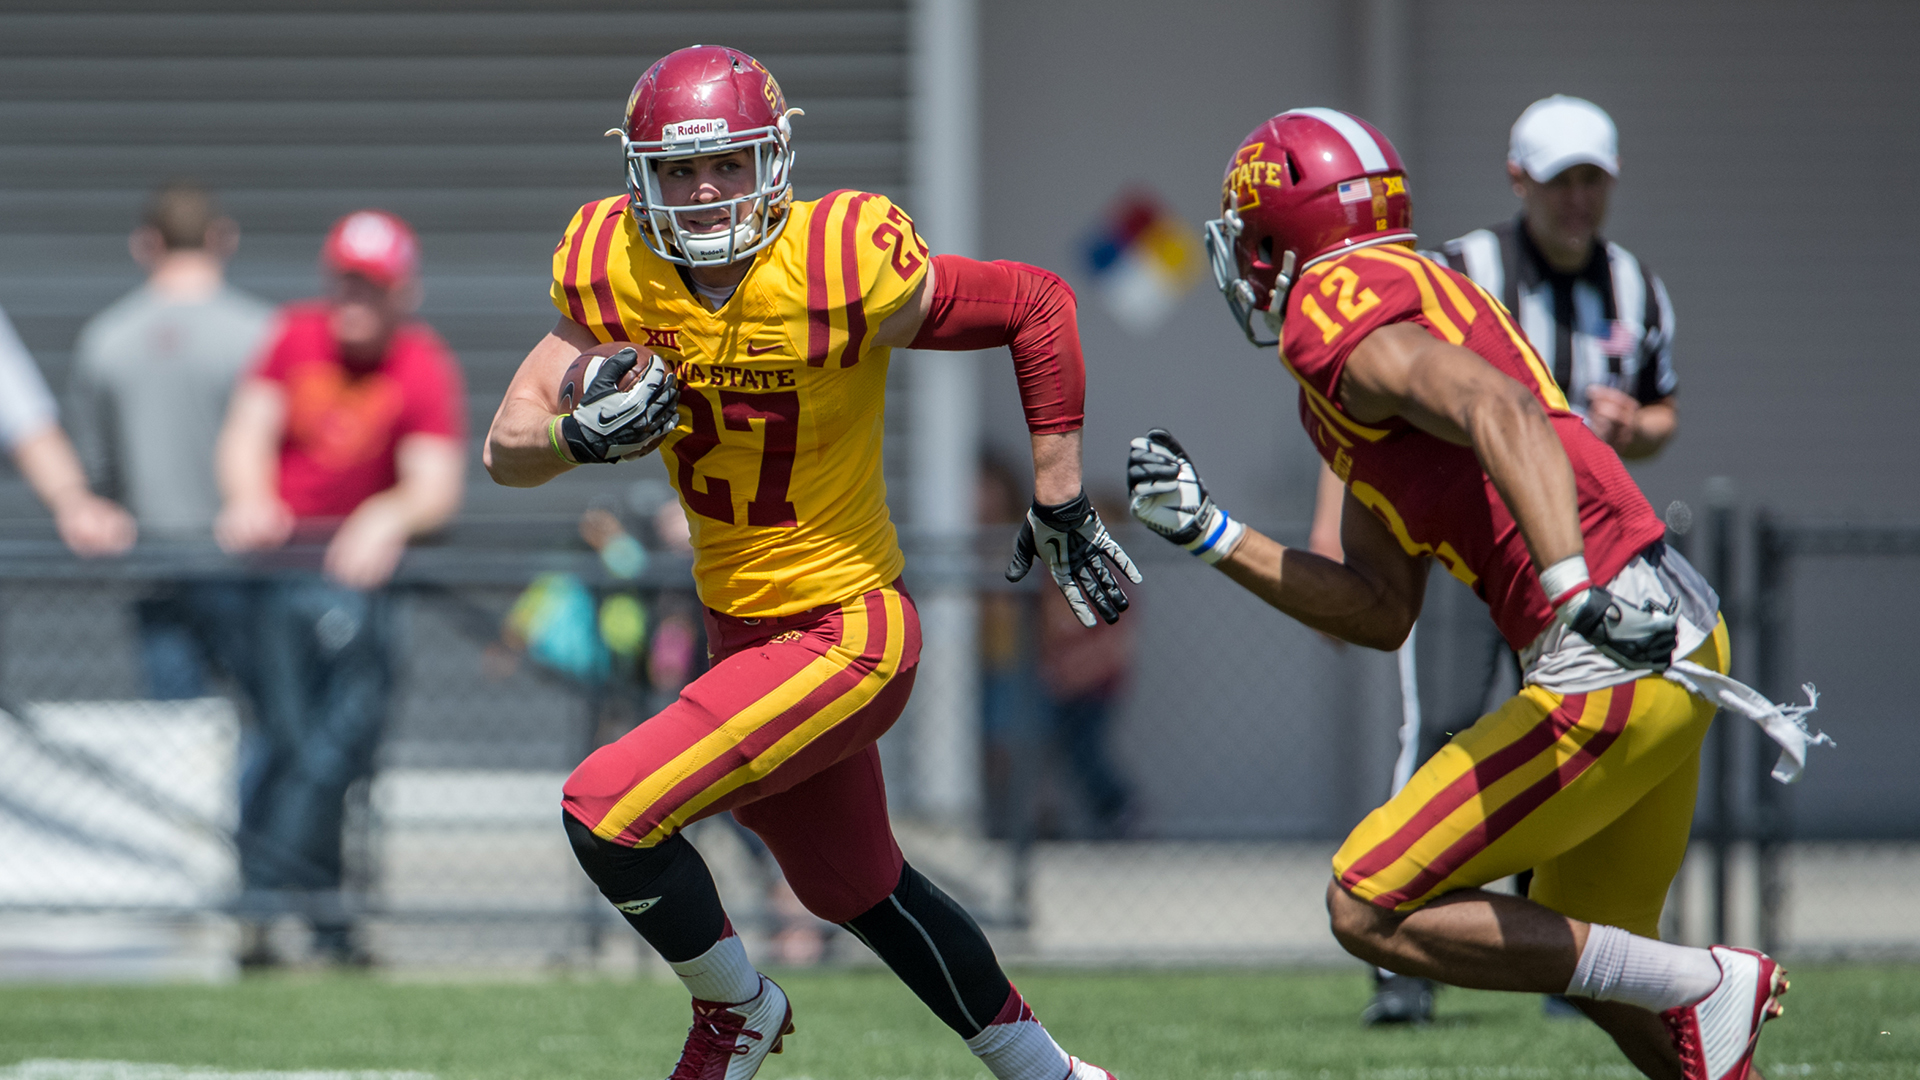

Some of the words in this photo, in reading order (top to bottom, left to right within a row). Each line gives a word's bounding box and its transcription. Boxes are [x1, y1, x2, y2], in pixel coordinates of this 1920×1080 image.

[677, 122, 713, 136] Riddell
[1376, 218, 1388, 231] 12
[871, 204, 930, 282] 27
[1301, 265, 1382, 345] 12
[640, 325, 682, 352] XII
[667, 359, 705, 383] WA
[710, 365, 796, 389] STATE
[671, 380, 800, 527] 27
